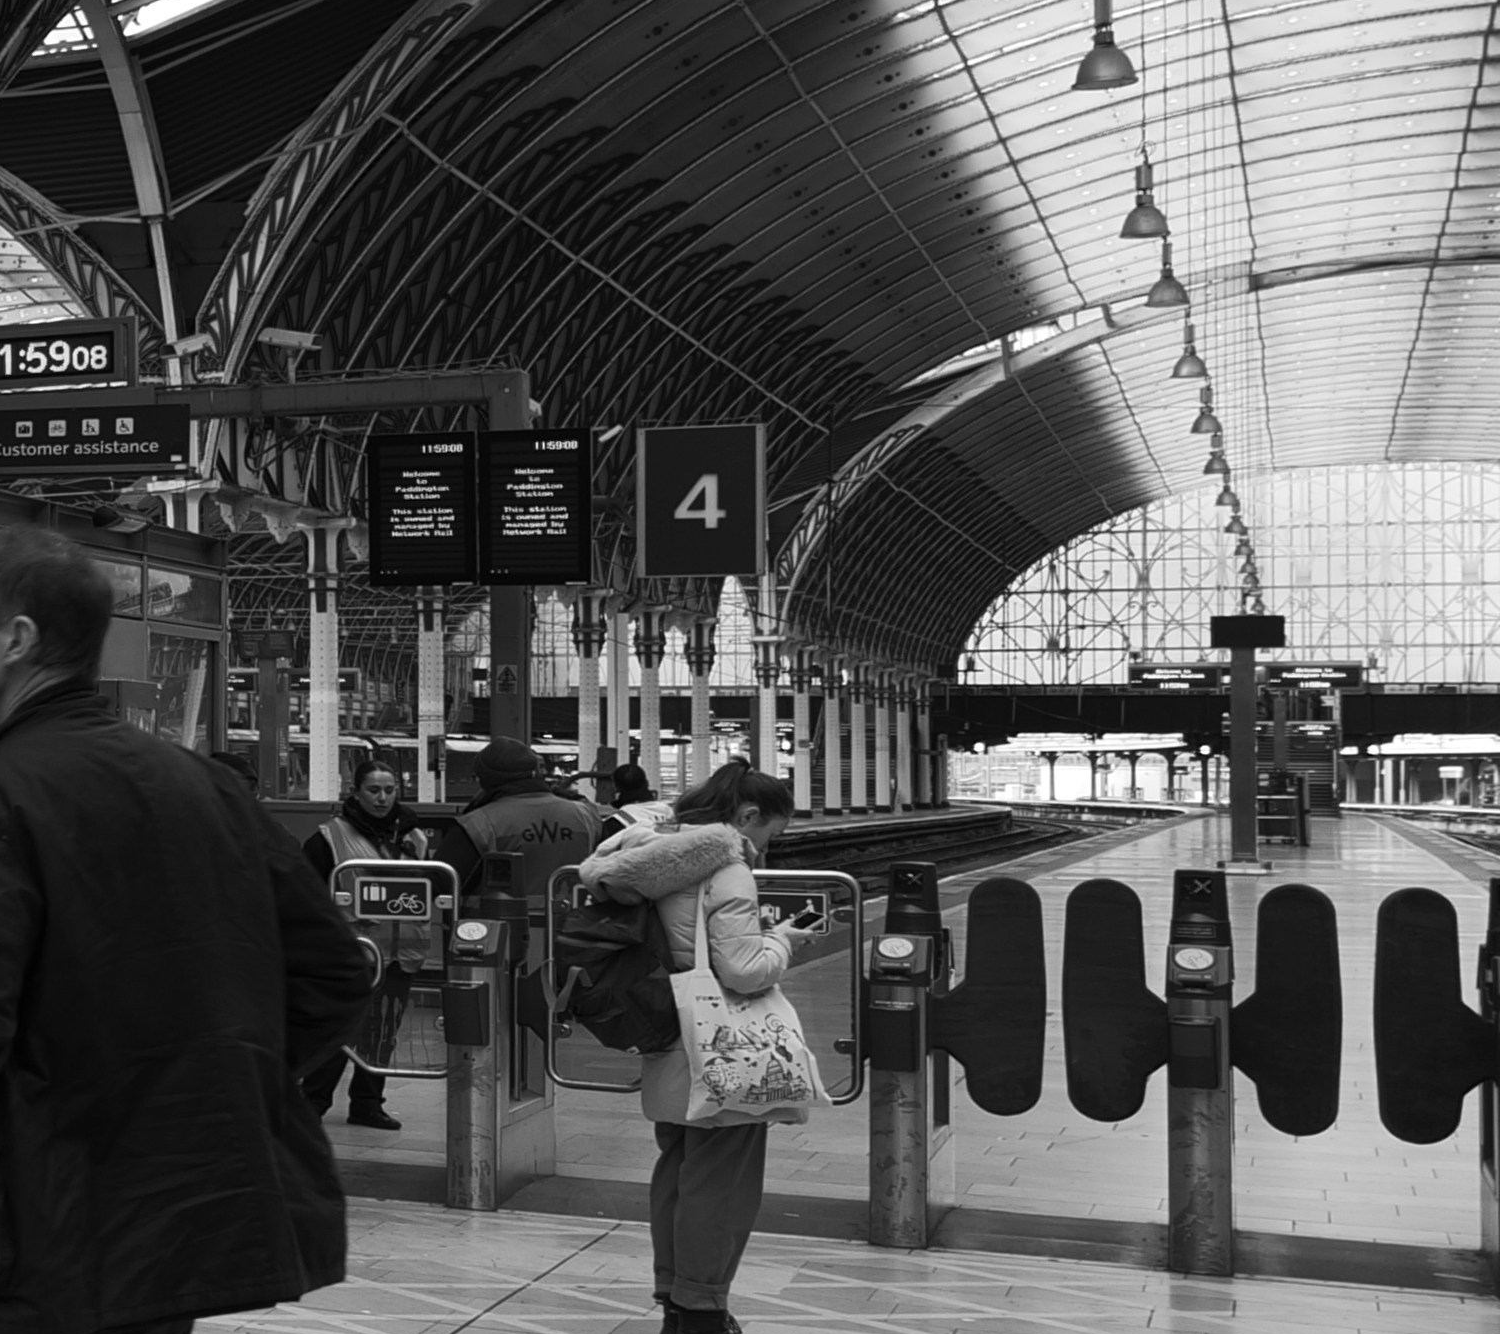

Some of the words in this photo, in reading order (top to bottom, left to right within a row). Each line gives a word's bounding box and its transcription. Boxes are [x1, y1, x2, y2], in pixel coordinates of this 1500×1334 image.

[73, 440, 160, 455] assistance
[673, 473, 727, 529] 4
[522, 819, 573, 843] GWR
